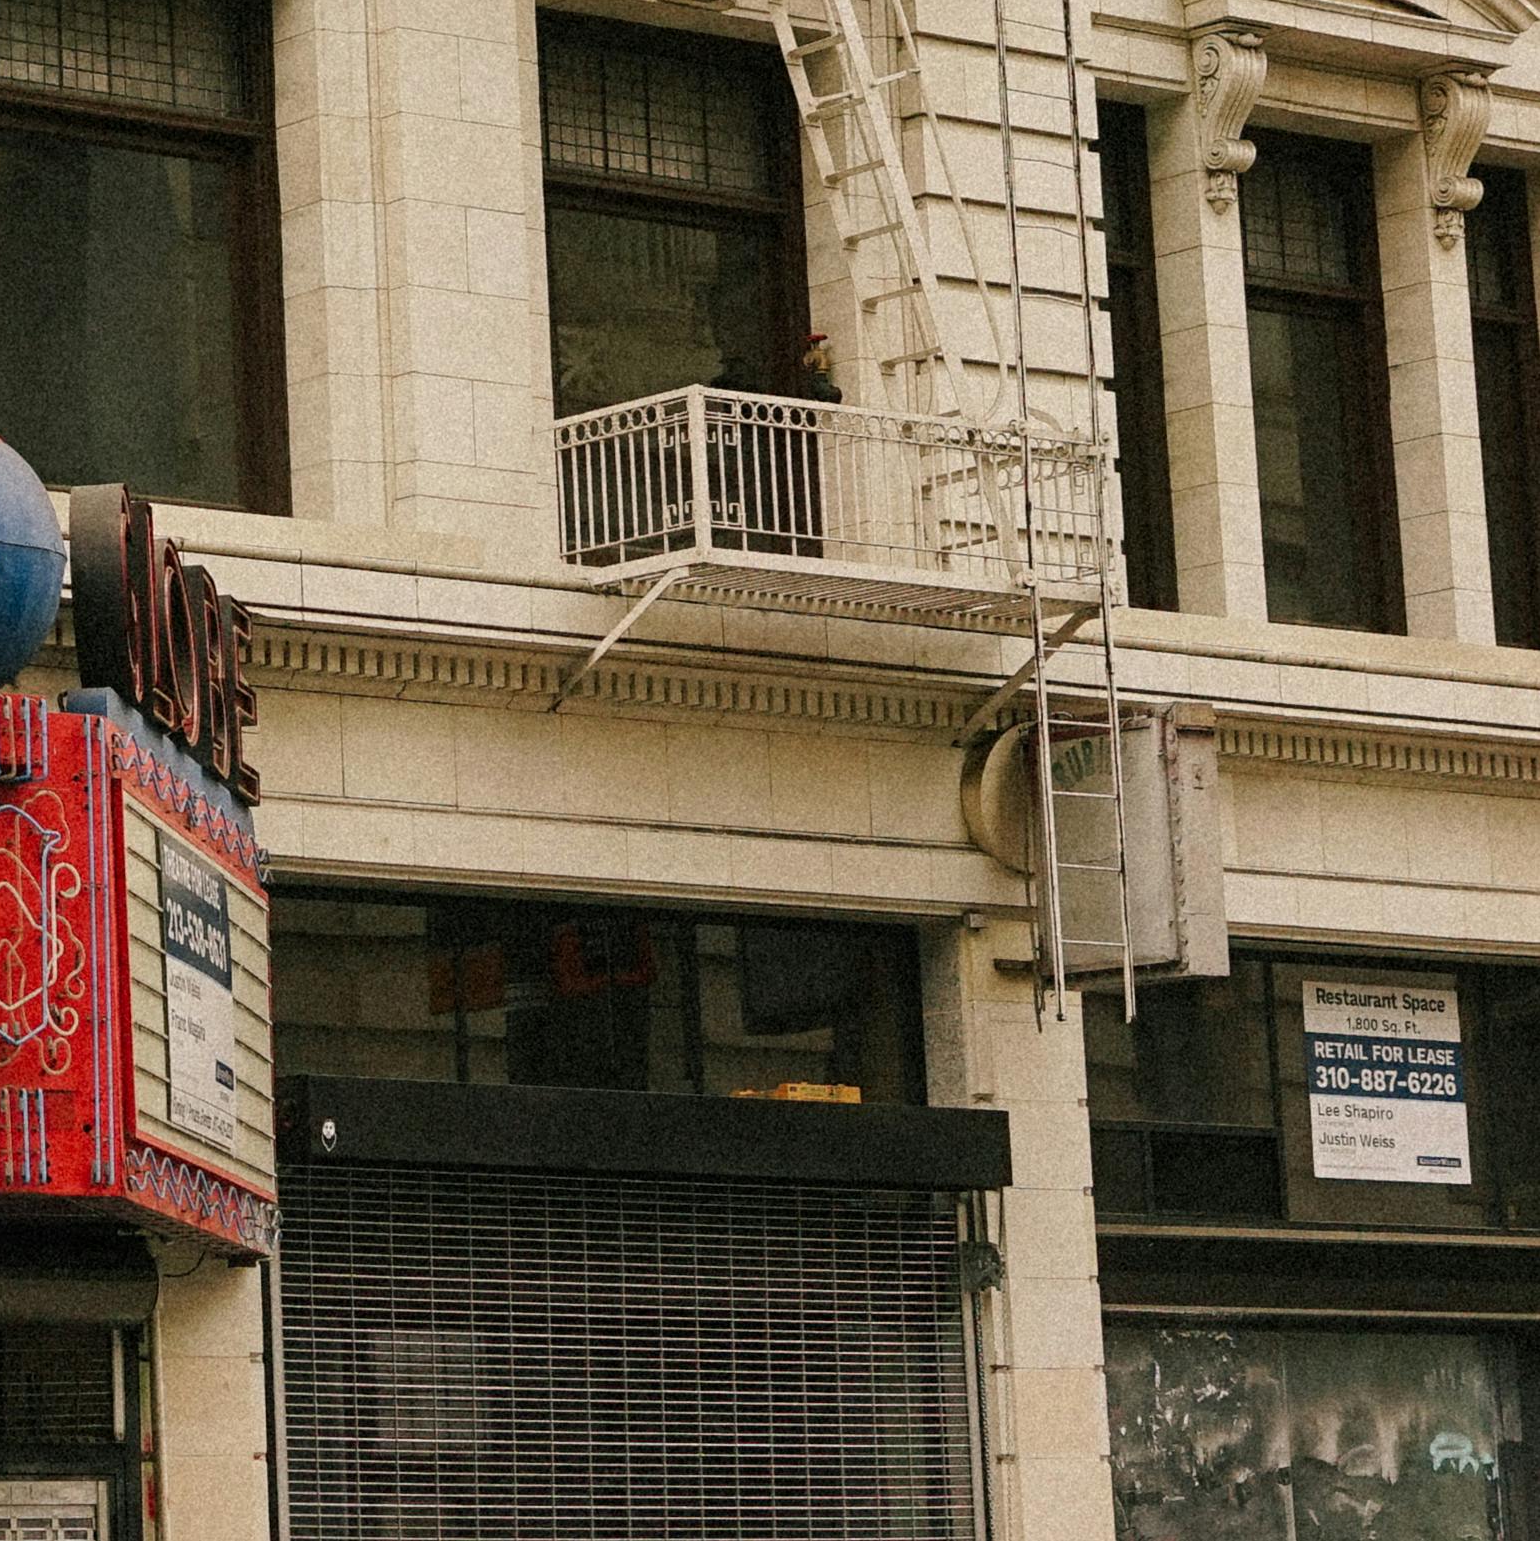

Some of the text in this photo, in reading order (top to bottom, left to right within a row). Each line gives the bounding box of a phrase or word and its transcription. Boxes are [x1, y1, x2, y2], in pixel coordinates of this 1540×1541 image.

[1315, 987, 1446, 1016] Restaurant Space
[1381, 1021, 1401, 1036] Sq.
[1404, 1021, 1422, 1035] Ft.
[1314, 1040, 1456, 1066] RETAIL FOR LEASE
[1315, 1065, 1458, 1097] 310-887-6226
[1317, 1103, 1394, 1122] Lee Shapiro
[1319, 1131, 1396, 1149] Justin Weiss
